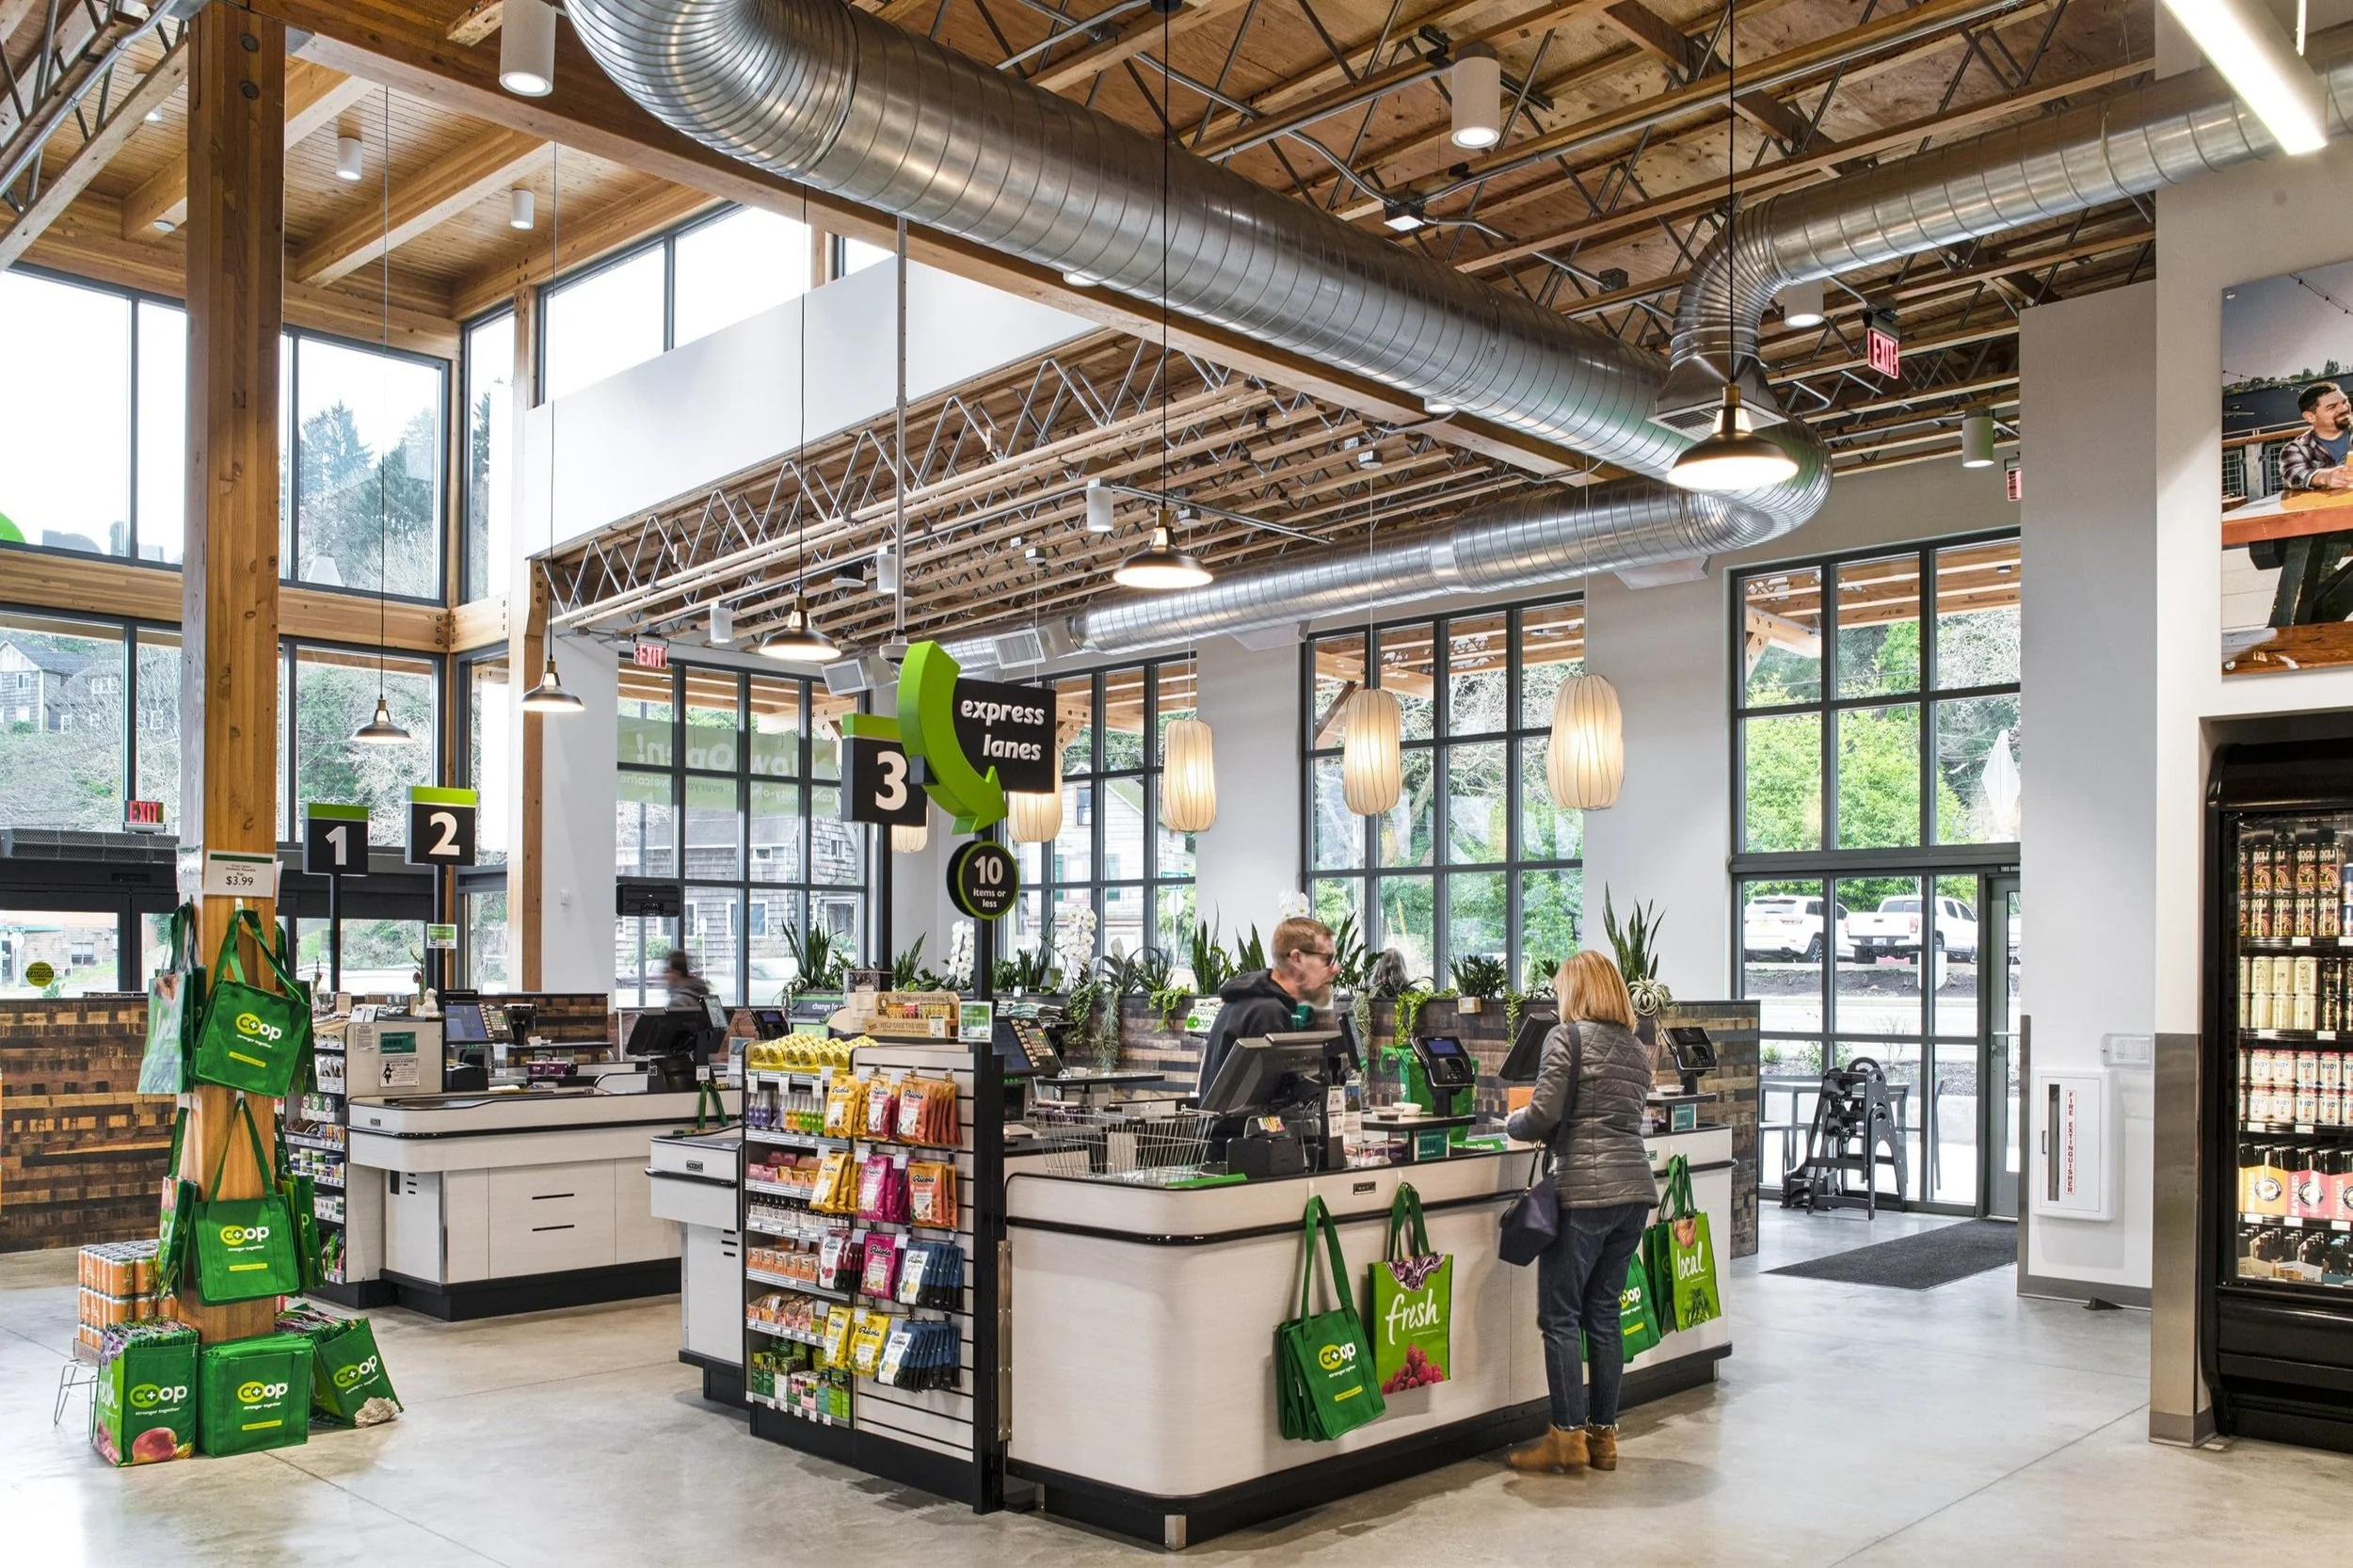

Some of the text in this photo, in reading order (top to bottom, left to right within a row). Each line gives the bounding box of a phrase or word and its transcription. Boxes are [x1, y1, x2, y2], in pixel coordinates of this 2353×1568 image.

[1873, 332, 1895, 375] EXIT
[639, 645, 663, 667] EXIT
[960, 699, 1045, 726] express
[983, 734, 1041, 760] lanes
[875, 750, 907, 810] 3
[130, 802, 158, 823] EXIT
[428, 811, 460, 856] 2
[325, 825, 346, 866] 1
[226, 875, 254, 886] $3.99
[974, 856, 1003, 885] 10
[973, 888, 995, 897] items
[982, 899, 998, 907] less
[812, 1002, 830, 1012] change
[904, 1089, 923, 1100] Ricola
[913, 1175, 936, 1183] Ricola
[870, 1245, 891, 1256] Ricola
[1677, 1241, 1706, 1280] local
[1385, 1288, 1440, 1346] fresh
[858, 1325, 880, 1337] Ricola
